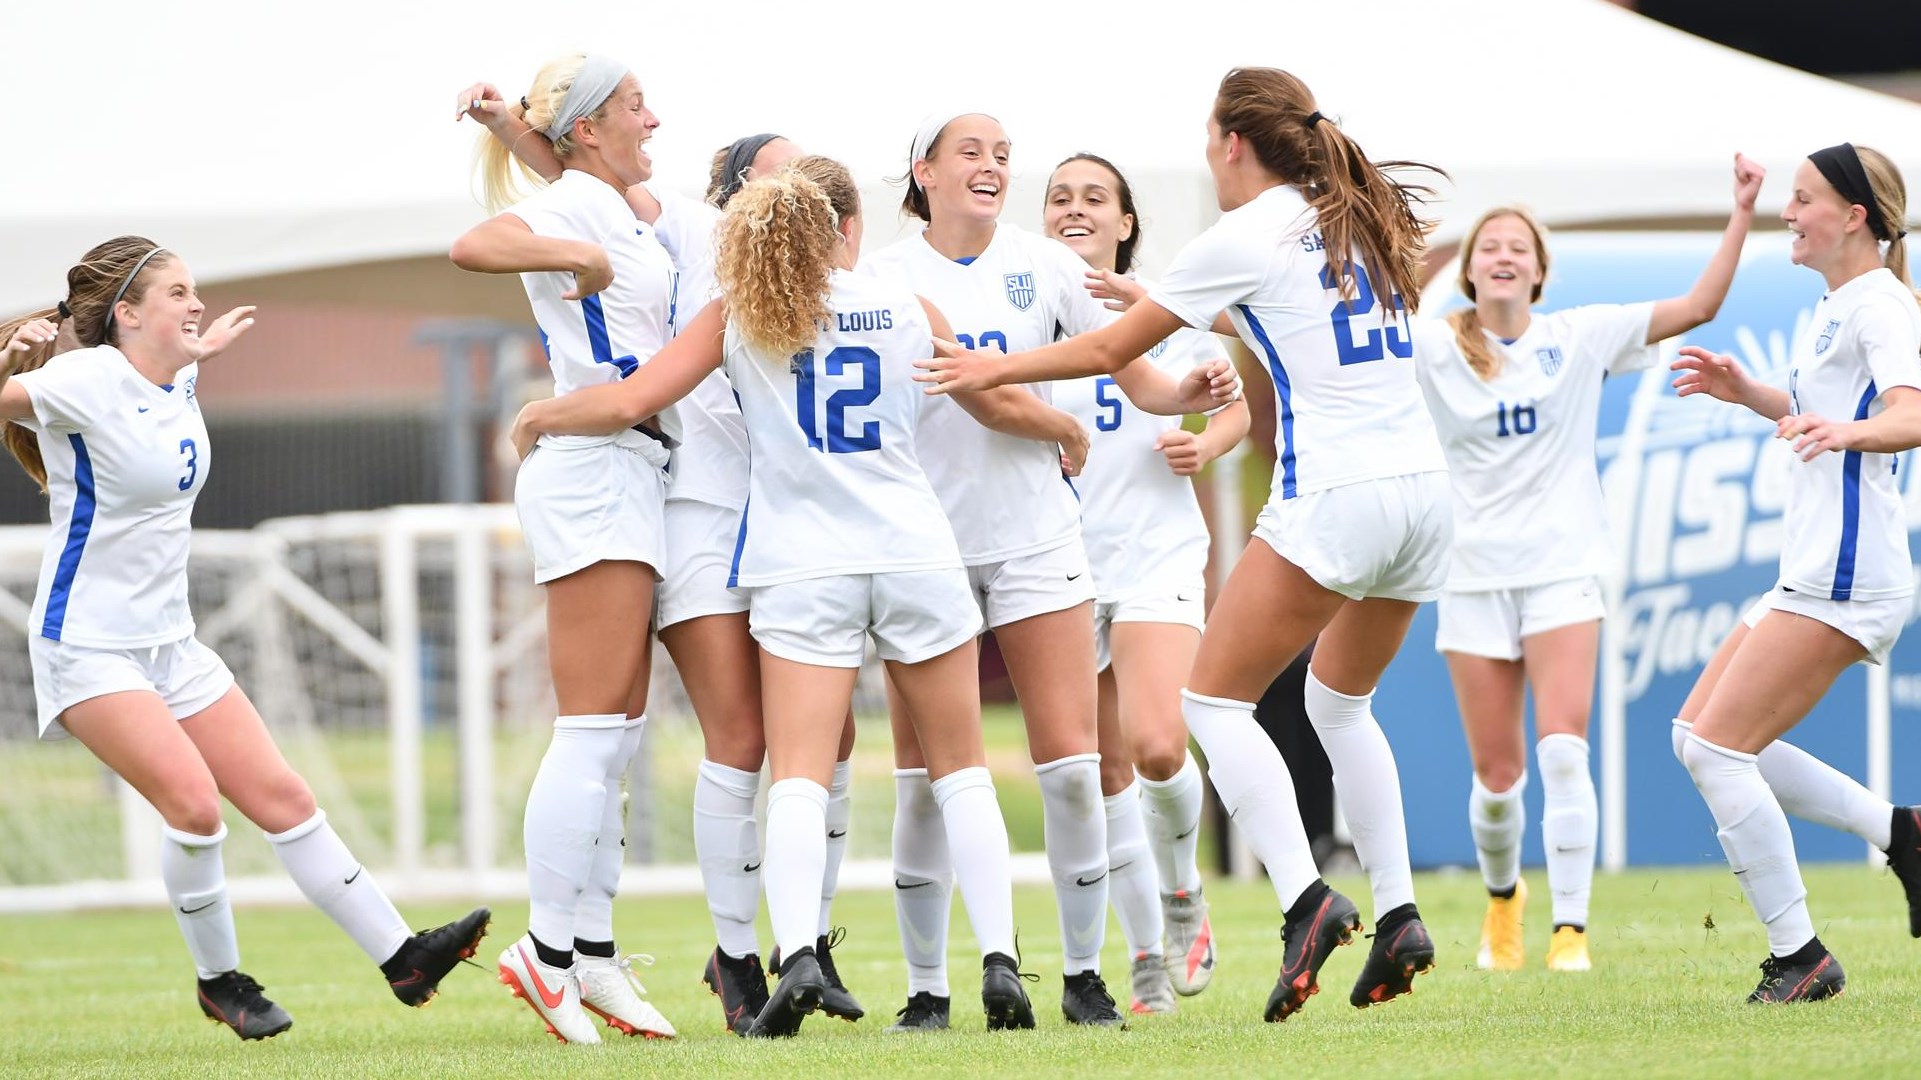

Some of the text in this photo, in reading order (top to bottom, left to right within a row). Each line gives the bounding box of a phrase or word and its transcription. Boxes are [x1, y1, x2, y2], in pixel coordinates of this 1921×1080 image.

[1007, 275, 1032, 291] SLU
[837, 309, 893, 332] LOUIS
[790, 346, 882, 453] 12
[1095, 378, 1122, 432] 5
[178, 438, 197, 491] 3
